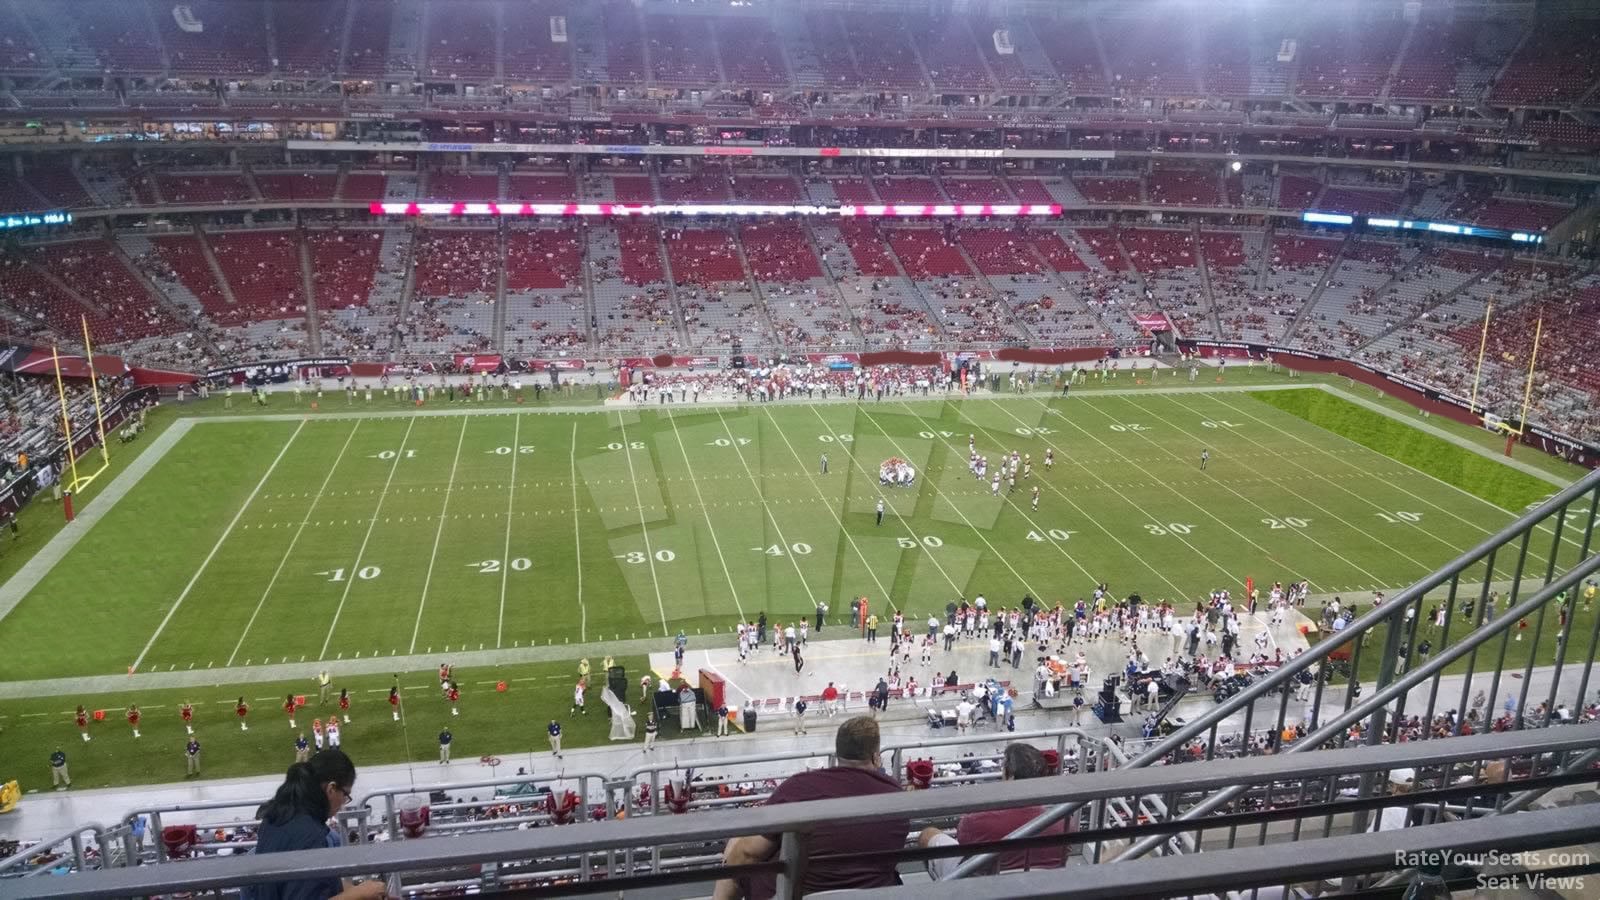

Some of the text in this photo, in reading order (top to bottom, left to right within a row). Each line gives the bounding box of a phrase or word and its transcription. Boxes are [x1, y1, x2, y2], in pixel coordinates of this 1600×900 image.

[1266, 347, 1319, 359] ARIZONA CARDINALS
[818, 433, 854, 443] 50
[1530, 427, 1583, 451] ARIZONA CARDINALS
[1261, 517, 1308, 529] 20
[1375, 511, 1420, 524] 10
[1025, 529, 1069, 543] 40
[1143, 522, 1191, 536] 30
[897, 536, 943, 549] 50
[626, 549, 676, 564] 30
[764, 543, 812, 557] 40
[479, 557, 532, 573] 20
[328, 565, 381, 582] 10
